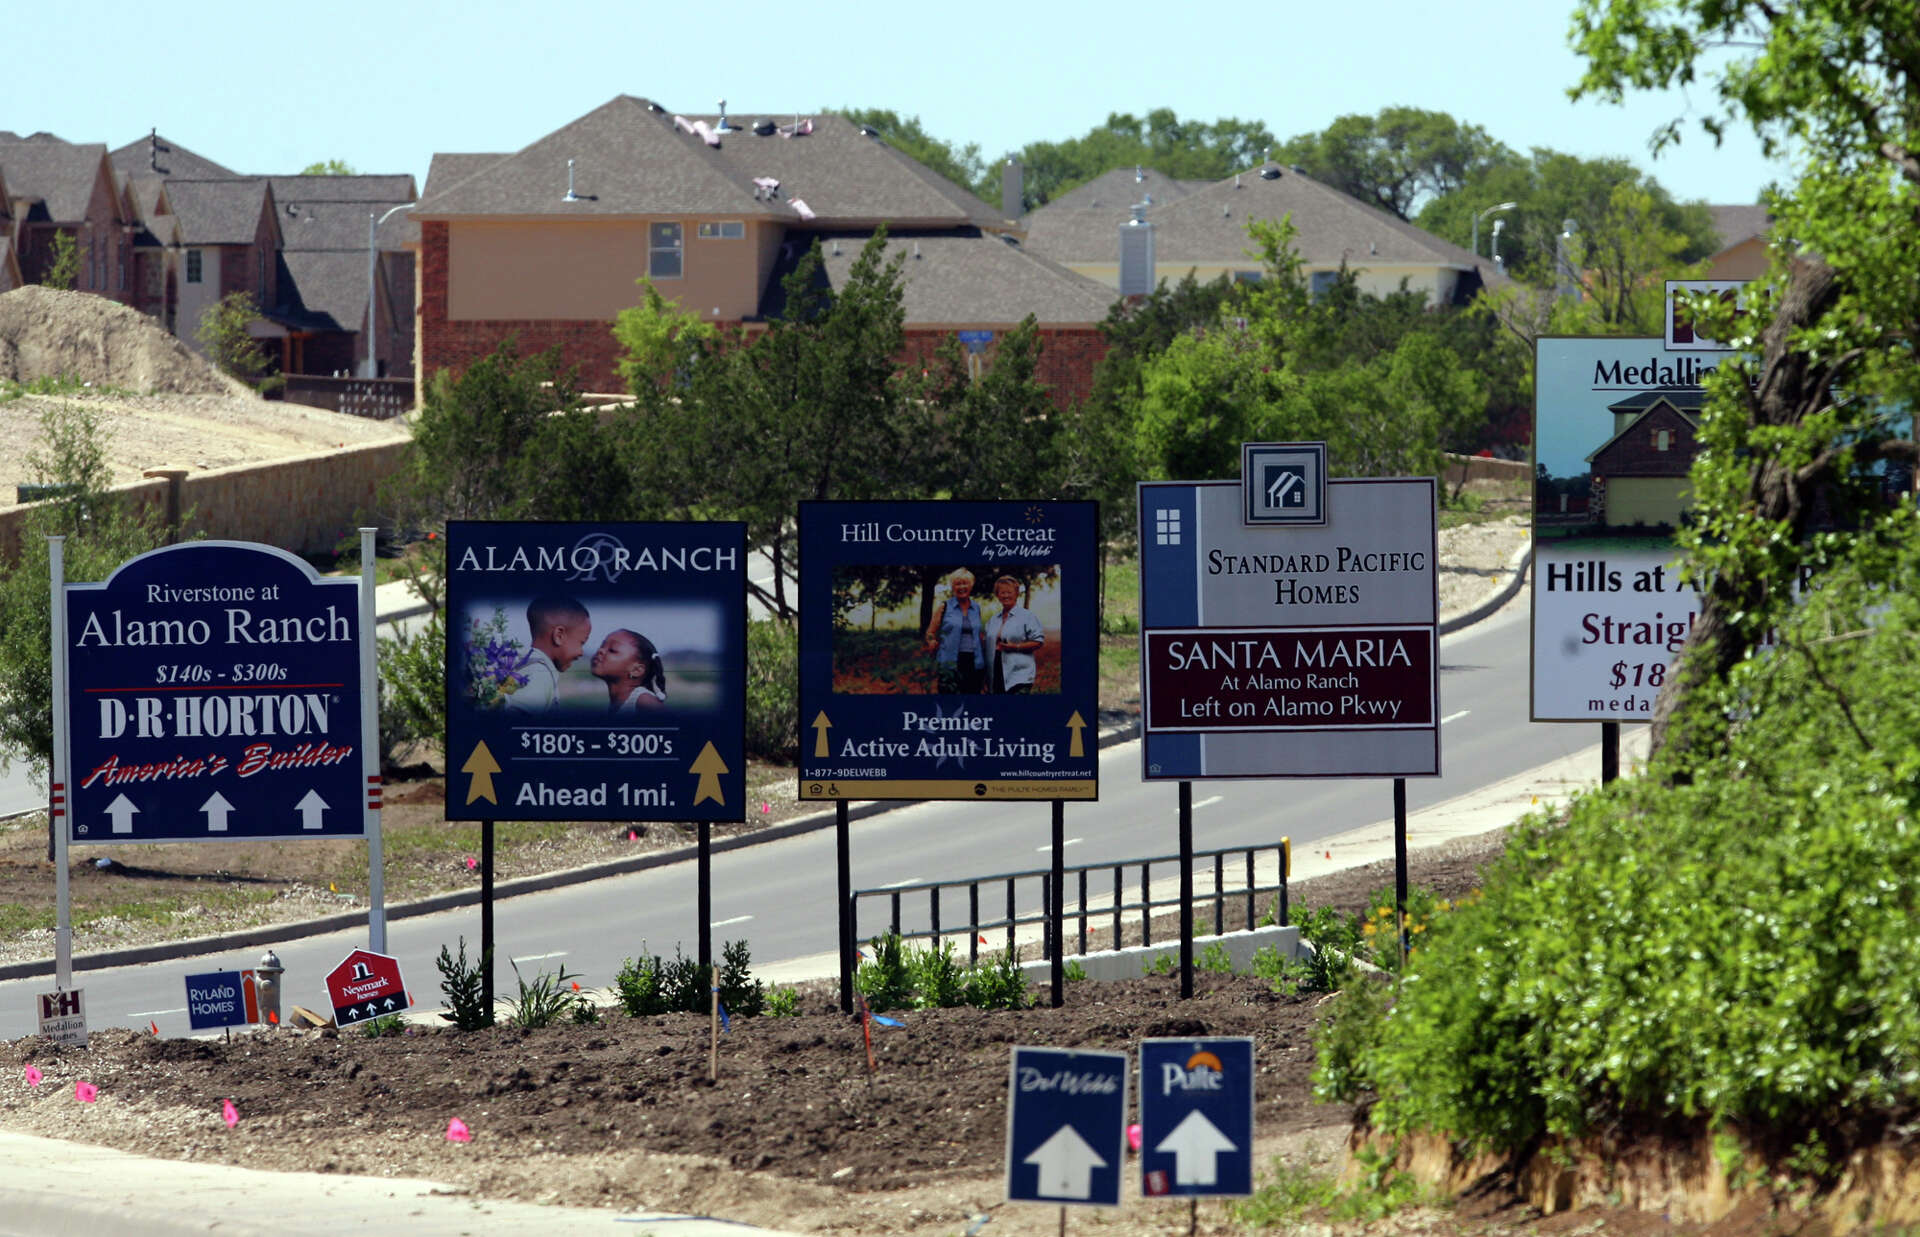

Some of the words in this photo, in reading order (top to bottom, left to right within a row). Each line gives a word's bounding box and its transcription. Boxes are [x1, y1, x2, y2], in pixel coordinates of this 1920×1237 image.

[1594, 357, 1718, 386] Medalli
[841, 523, 880, 542] Hill
[886, 523, 976, 548] Country
[980, 523, 1056, 542] Retreat
[456, 546, 600, 572] ALAMO
[614, 547, 736, 571] RANCH
[982, 545, 995, 561] by
[996, 543, 1019, 557] Del
[1019, 544, 1052, 558] Webb
[1207, 548, 1330, 576] STANDARD
[1336, 547, 1425, 573] PACIFIC
[1547, 560, 1622, 592] Hills
[1633, 564, 1665, 592] at
[147, 584, 255, 603] Riverstone
[261, 584, 280, 601] at
[1274, 579, 1359, 605] HOMES
[75, 609, 211, 647] Alamo
[224, 605, 352, 645] Ranch
[1581, 611, 1696, 654] Straig
[1168, 640, 1281, 670] SANTA
[1294, 638, 1412, 668] MARIA
[156, 664, 212, 684] $140s
[232, 663, 288, 682] $300s
[1220, 674, 1240, 690] At
[1245, 673, 1301, 690] Alamo
[1306, 672, 1359, 689] Ranch
[1609, 659, 1667, 690] $18
[1181, 696, 1221, 718] Left
[1229, 701, 1256, 717] on
[1263, 696, 1333, 717] Alamo
[1340, 694, 1402, 720] Pkwy
[902, 711, 993, 731] Premier
[521, 732, 585, 754] $180's
[607, 732, 673, 755] $300's
[840, 737, 910, 758] Active
[913, 737, 978, 758] Adult
[984, 737, 1056, 764] Living
[81, 752, 229, 789] America's
[236, 741, 353, 779] Builder
[804, 768, 888, 777] 1-877-9DELWEBB
[1000, 769, 1092, 779] www.hillcountryretreat.net
[515, 782, 607, 806] Ahead
[992, 785, 1005, 793] THE
[190, 987, 236, 1001] RYLAND
[342, 976, 390, 997] Newmark
[191, 1001, 235, 1015] HOMES
[42, 1020, 84, 1033] Medallion
[1019, 1066, 1059, 1092] Del
[1060, 1071, 1121, 1095] Webb
[1161, 1062, 1224, 1096] Pulte
